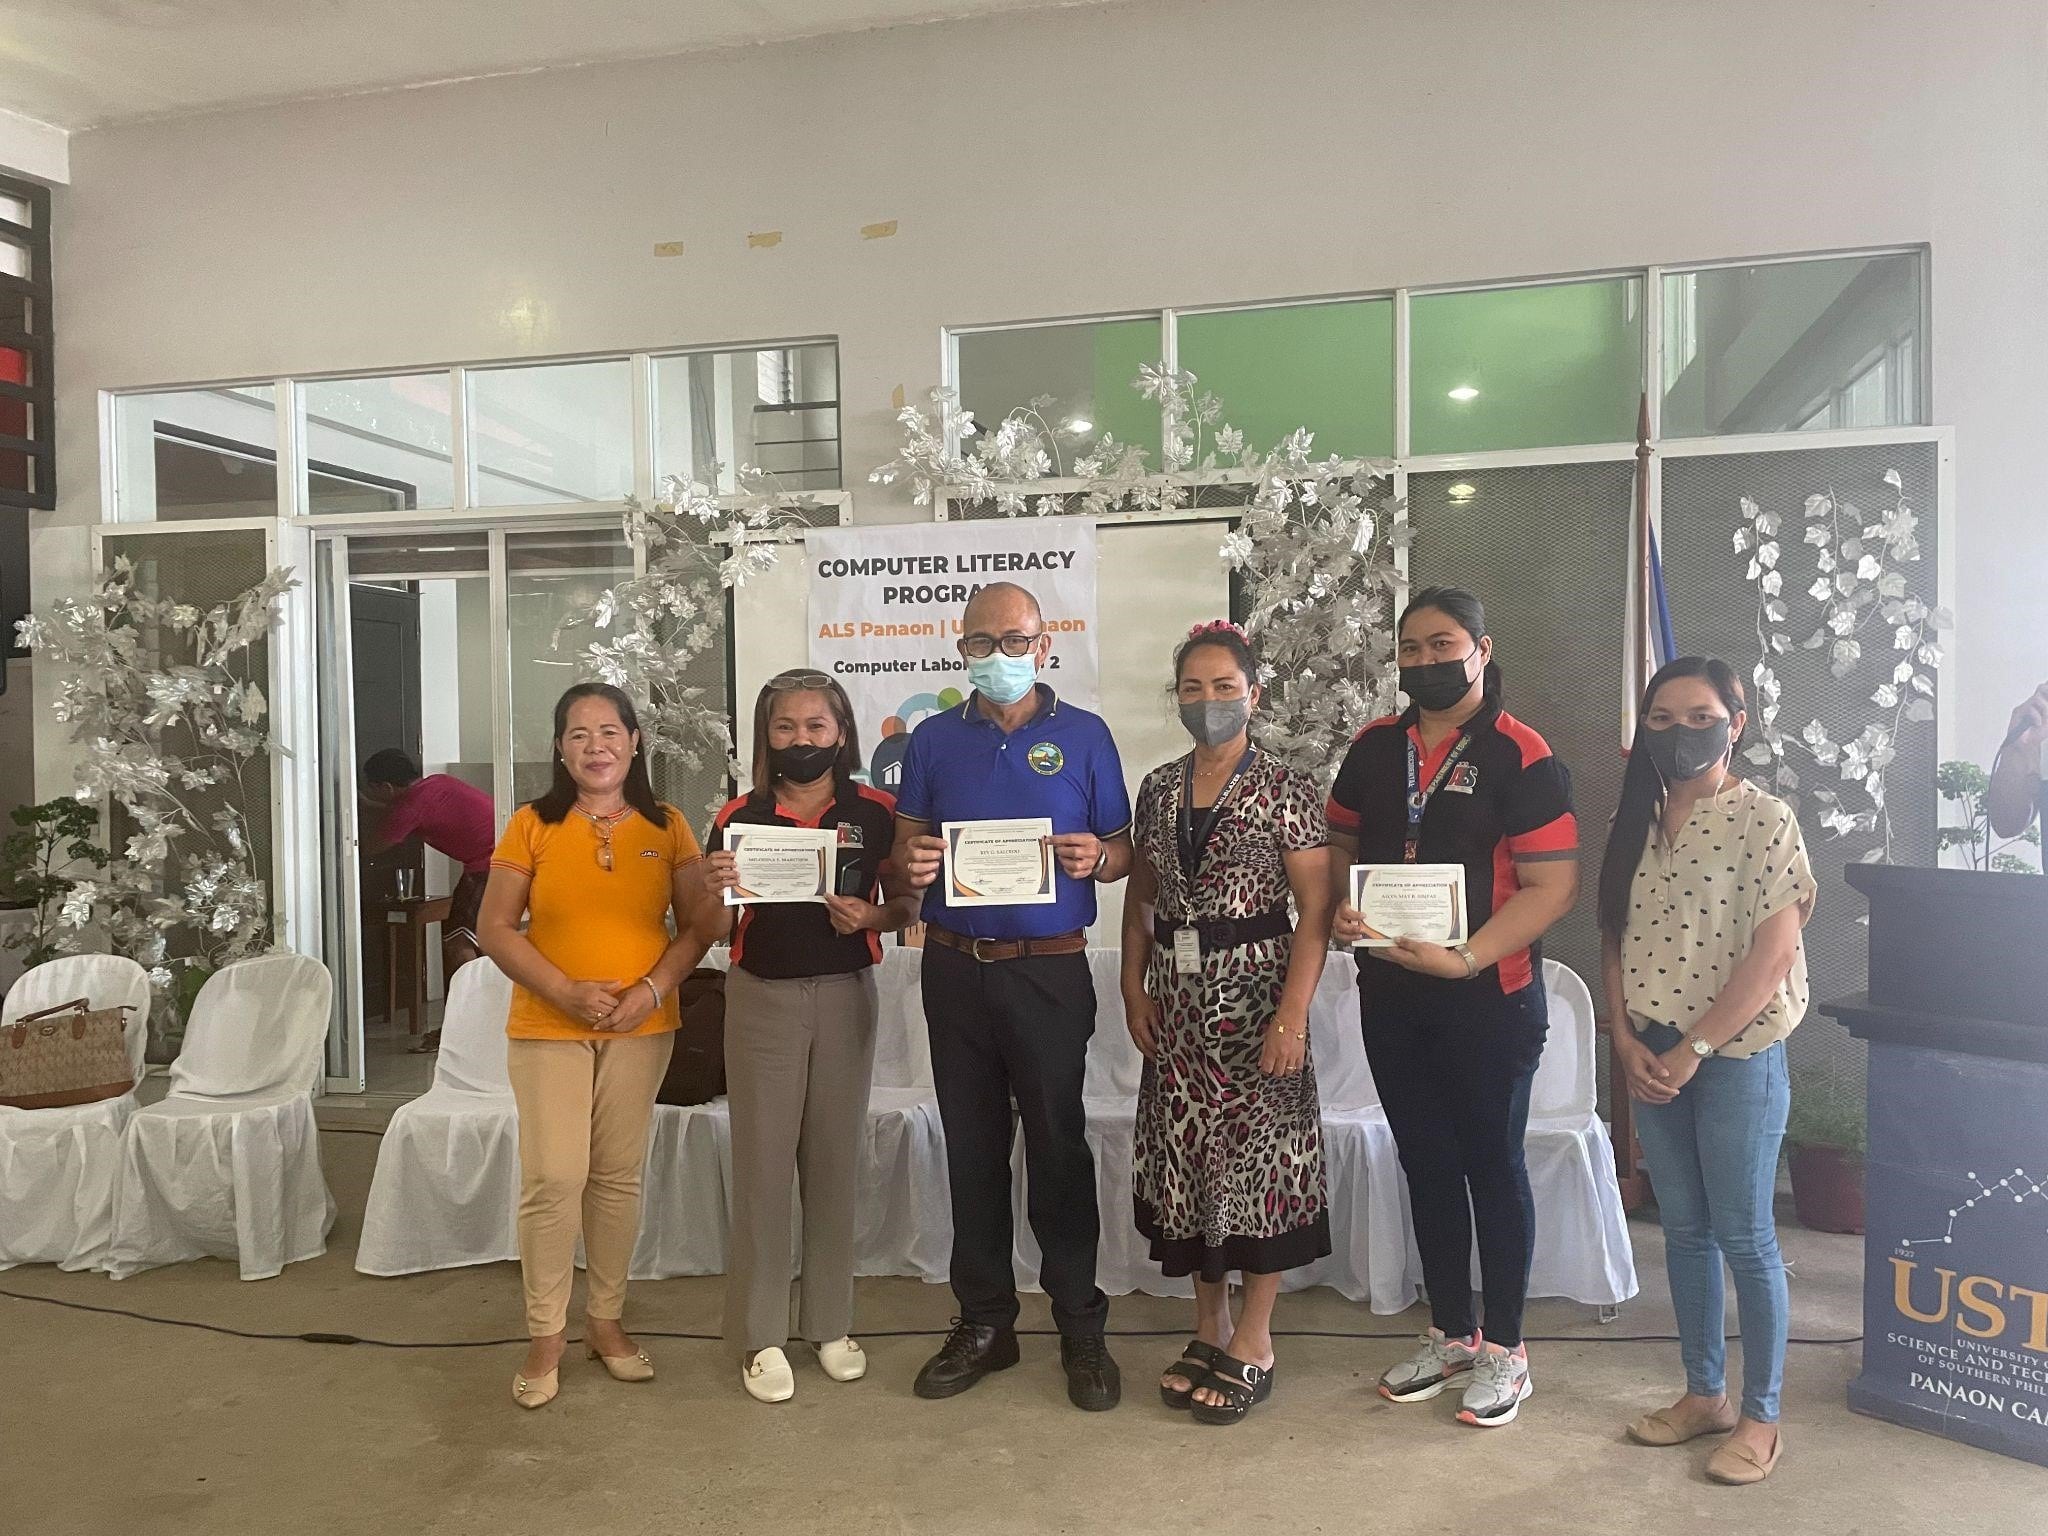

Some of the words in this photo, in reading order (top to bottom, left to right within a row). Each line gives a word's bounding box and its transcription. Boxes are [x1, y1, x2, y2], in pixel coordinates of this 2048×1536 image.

[818, 555, 949, 578] COMPUTER
[956, 550, 1076, 573] LITERACY
[883, 583, 994, 604] PROGRA
[818, 622, 855, 639] ALS
[860, 622, 934, 637] Panaon
[833, 659, 917, 675] Computer
[1049, 655, 1060, 669] 2
[1212, 773, 1242, 813] TRAILBLAZER
[1887, 1332, 1959, 1360] SCIENCE
[1965, 1353, 2004, 1371] AND
[1957, 1339, 2039, 1367] UNIVERSITY
[1918, 1354, 1935, 1365] OF
[1939, 1360, 2011, 1386] SOUTHERN
[1910, 1372, 2005, 1413] PANAON
